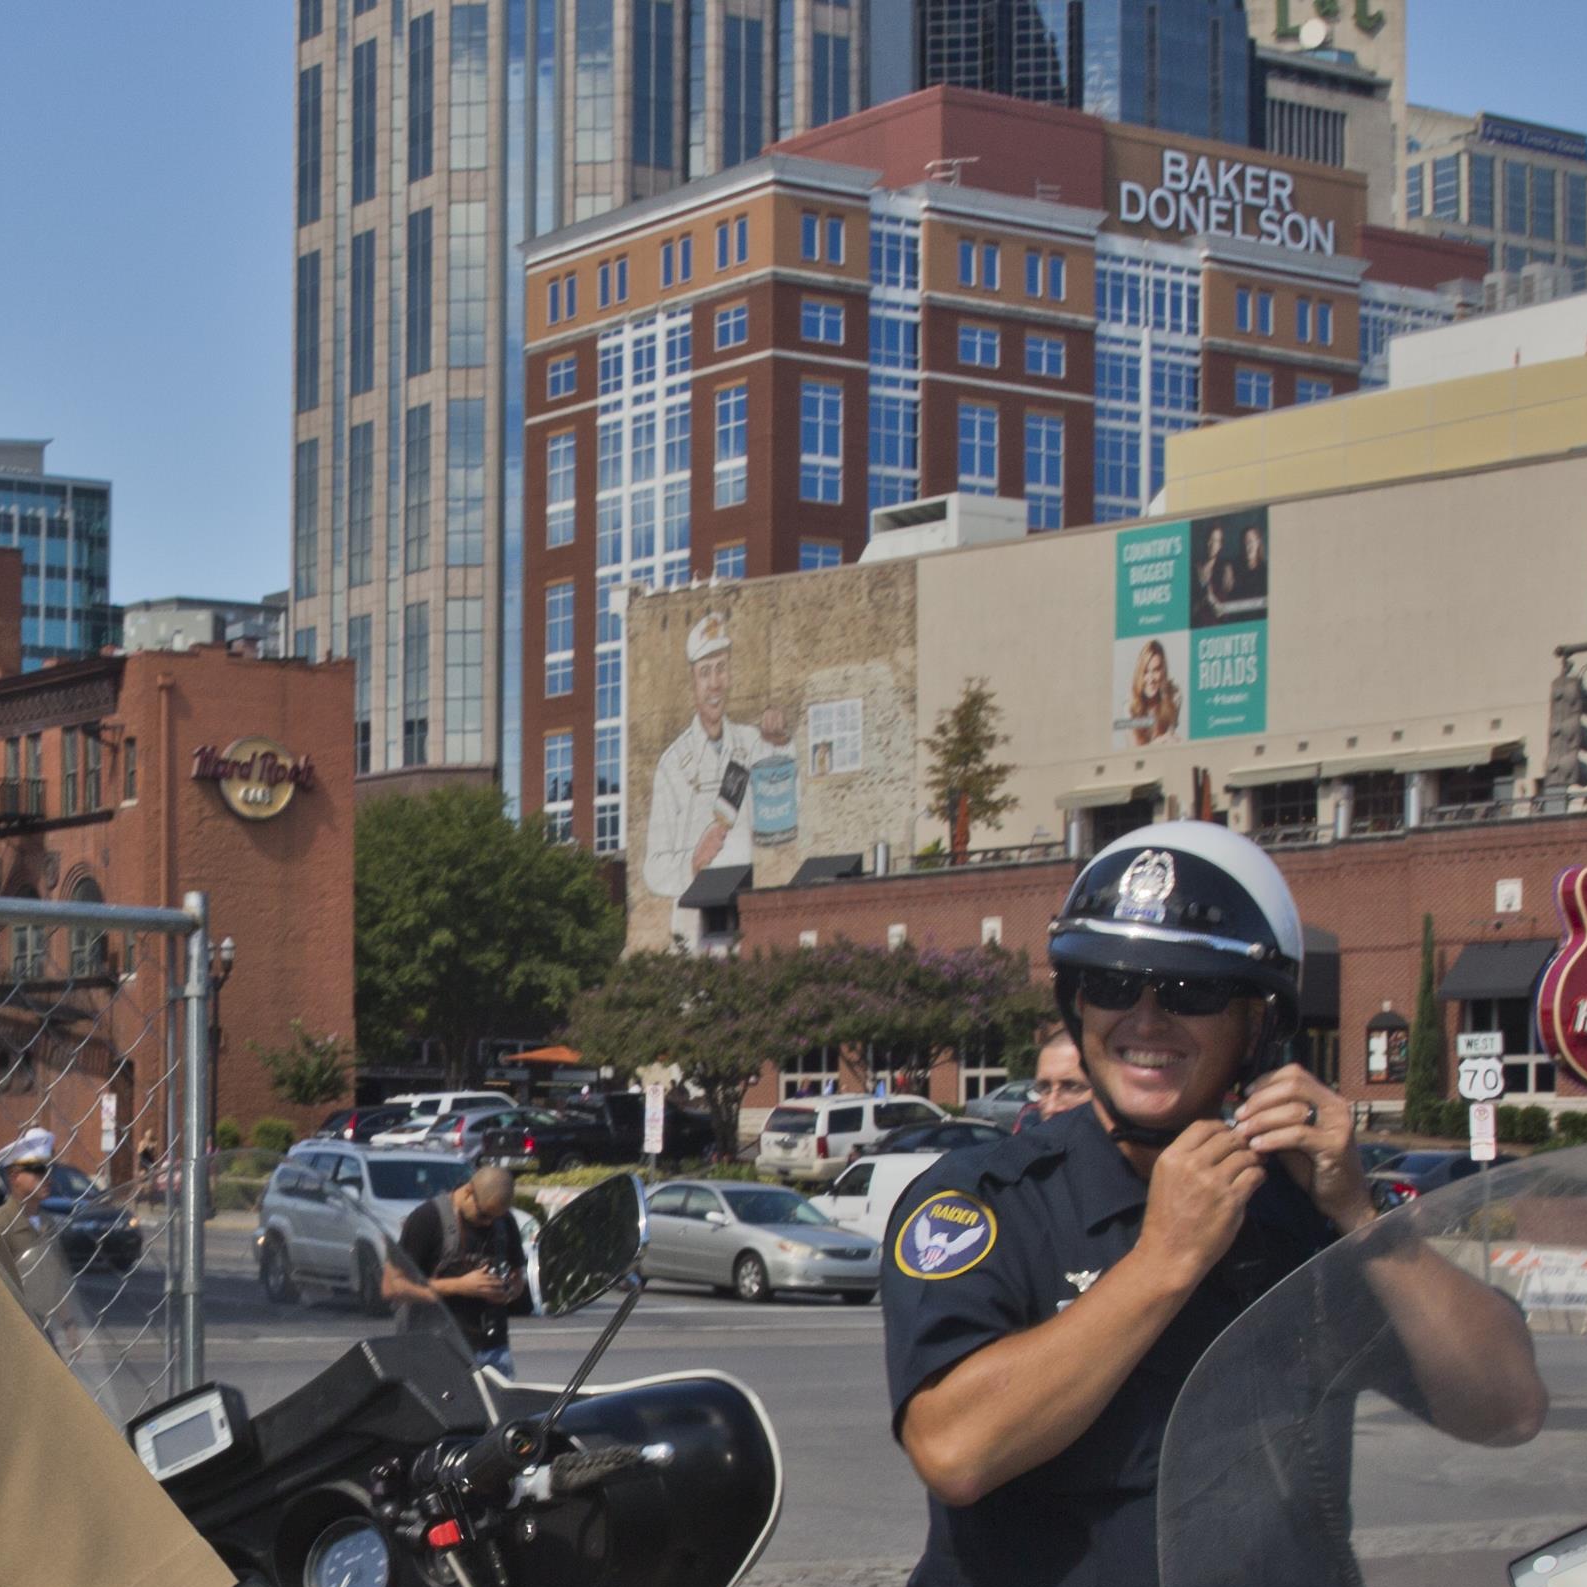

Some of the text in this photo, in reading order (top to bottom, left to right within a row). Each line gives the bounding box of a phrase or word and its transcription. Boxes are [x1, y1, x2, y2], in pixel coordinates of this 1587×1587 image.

[1164, 149, 1294, 213] BAKER
[1119, 181, 1335, 257] DONELSON
[1123, 536, 1182, 563] COUNTRY'S
[1129, 560, 1175, 585] BIGGEST
[1133, 584, 1171, 608] NAMES
[1198, 631, 1258, 661] COUNTRY
[1198, 656, 1258, 690] ROADS
[192, 745, 315, 790] Hard Rock
[1466, 1038, 1495, 1051] WEST
[1464, 1068, 1499, 1091] 70
[929, 1203, 980, 1226] RAIDER
